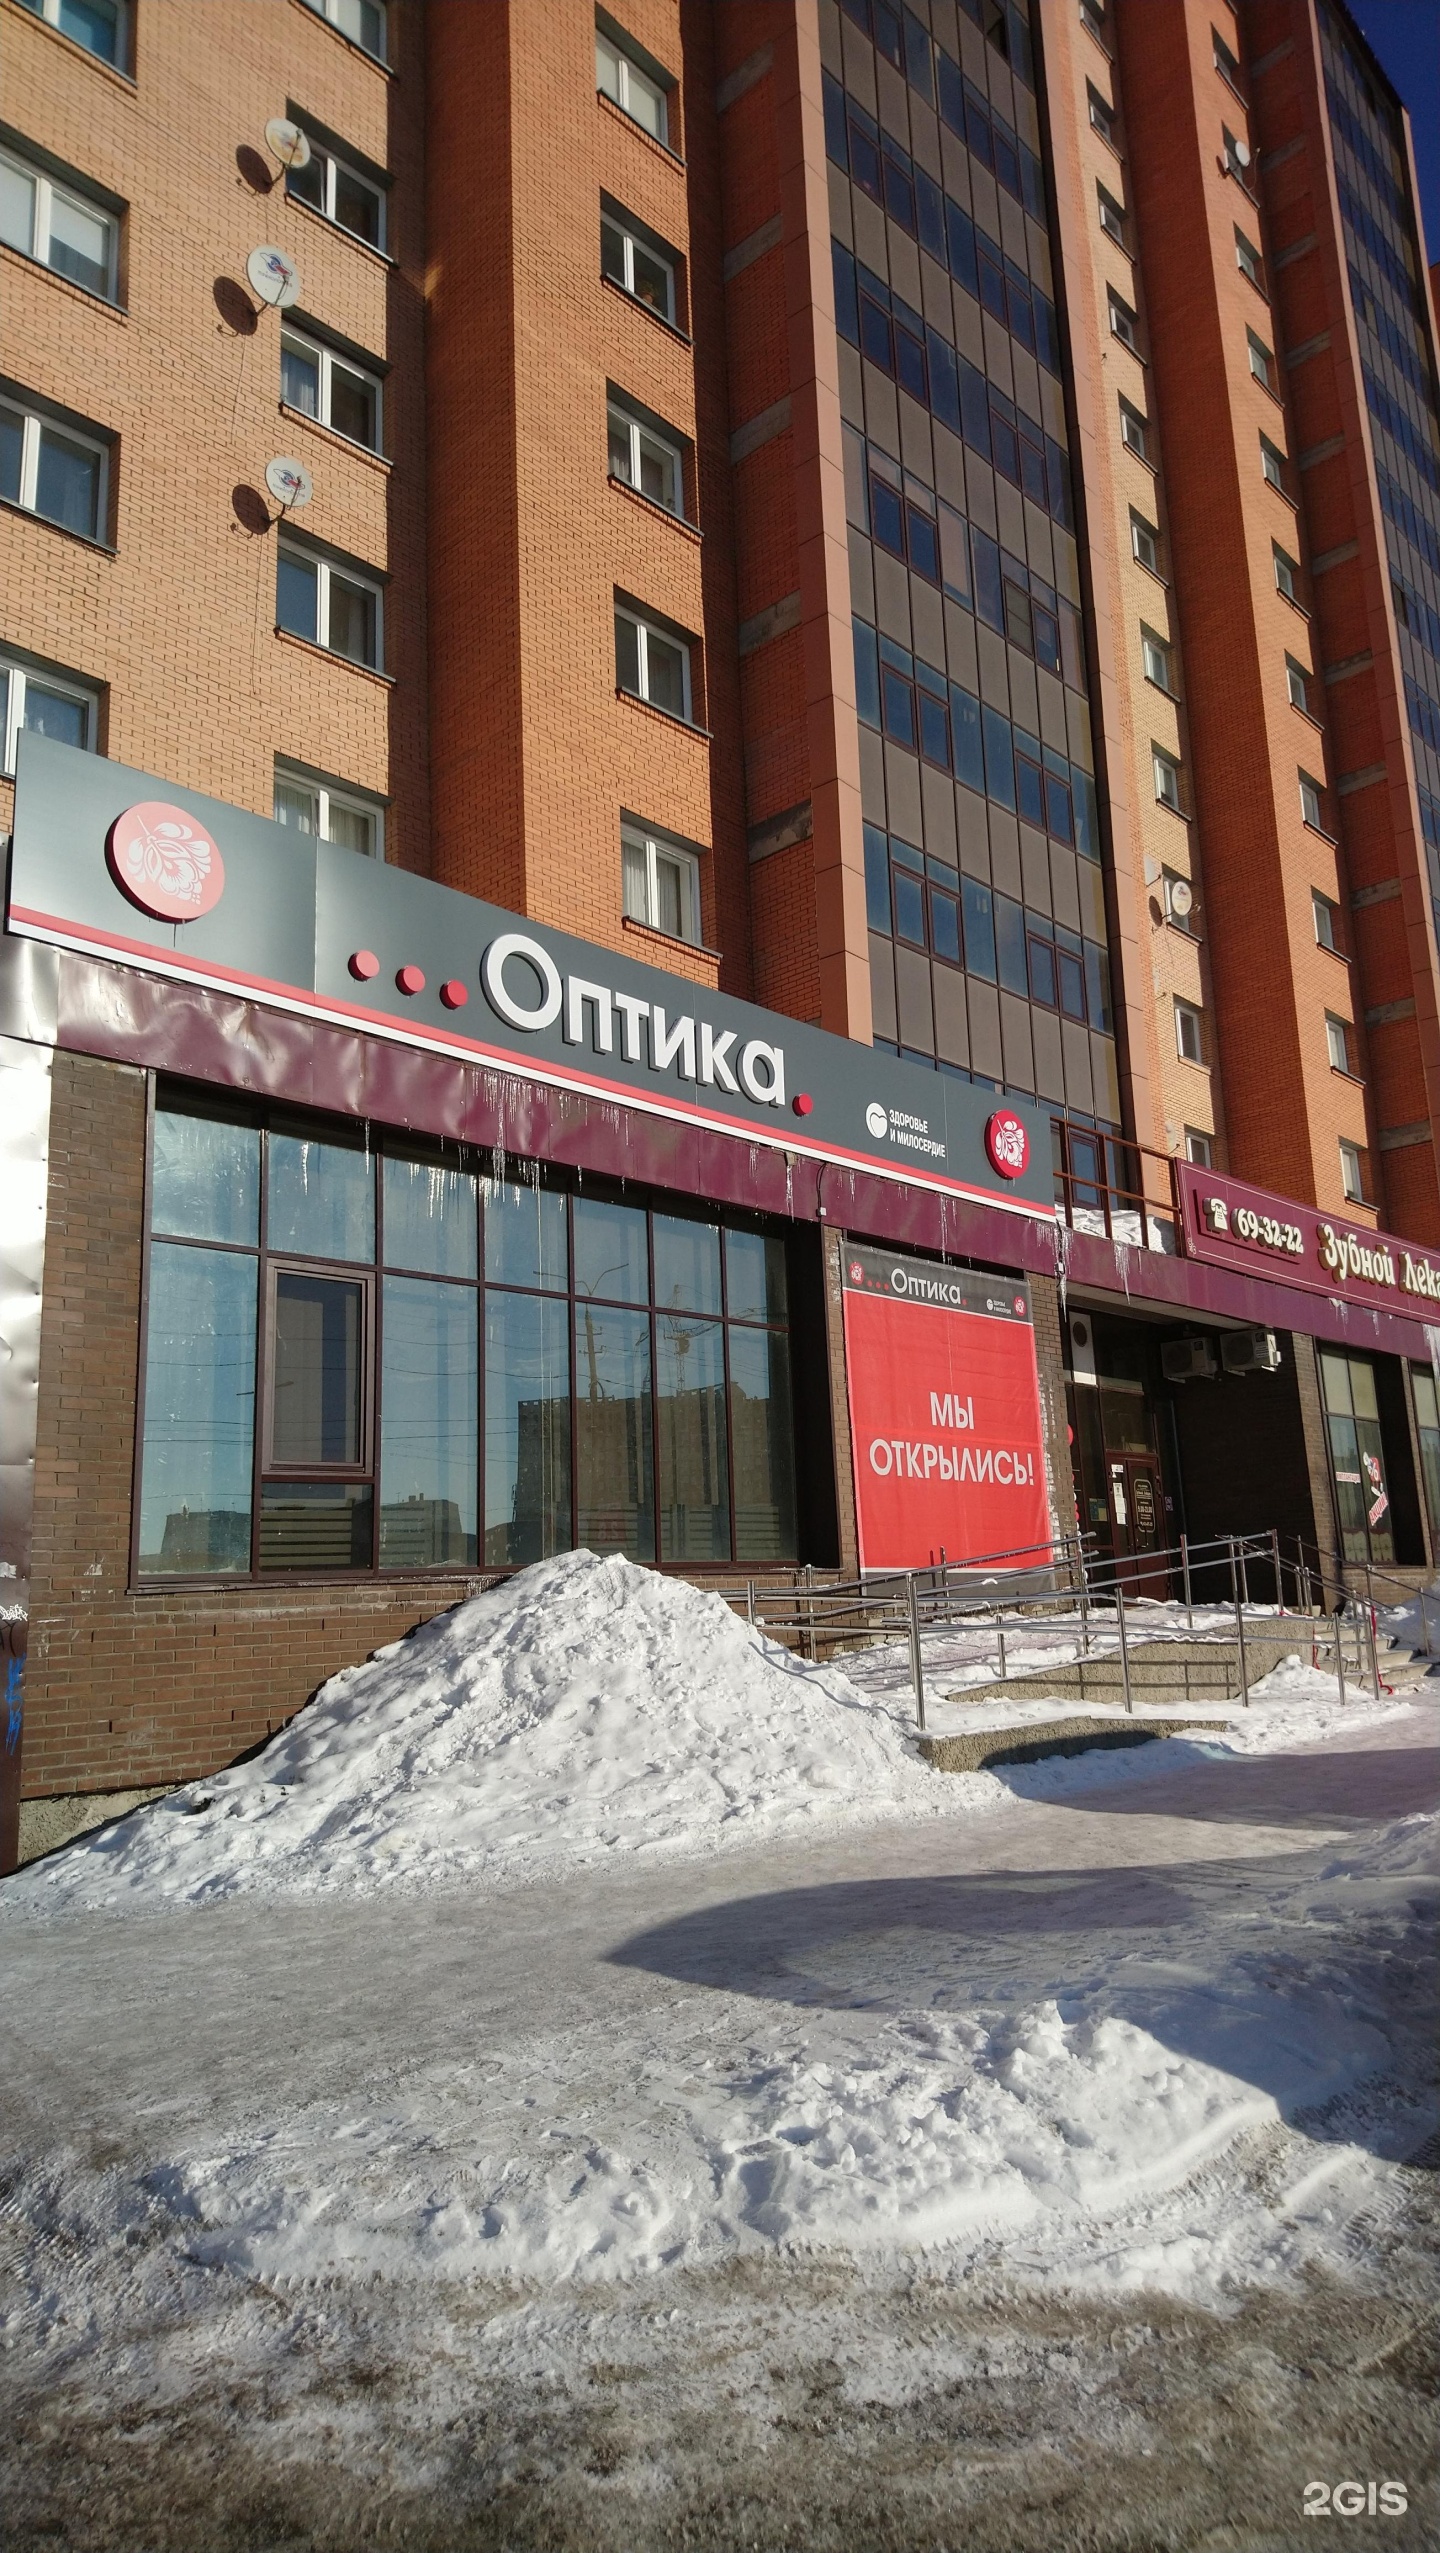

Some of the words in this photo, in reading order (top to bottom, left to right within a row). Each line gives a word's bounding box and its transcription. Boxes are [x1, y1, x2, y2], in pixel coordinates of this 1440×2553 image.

[480, 934, 786, 1107] Оптика
[889, 1108, 929, 1134] ЗДОРОВЬЕ
[889, 1128, 896, 1143] И
[897, 1130, 946, 1158] МИЛОСЕРДИЕ
[1235, 1207, 1305, 1255] 69-32-22
[1321, 1224, 1396, 1286] Зубной
[890, 1268, 962, 1304] Оптика
[929, 1391, 975, 1430] МЫ
[869, 1438, 1035, 1486] ОТКРЫЛИСЬ!
